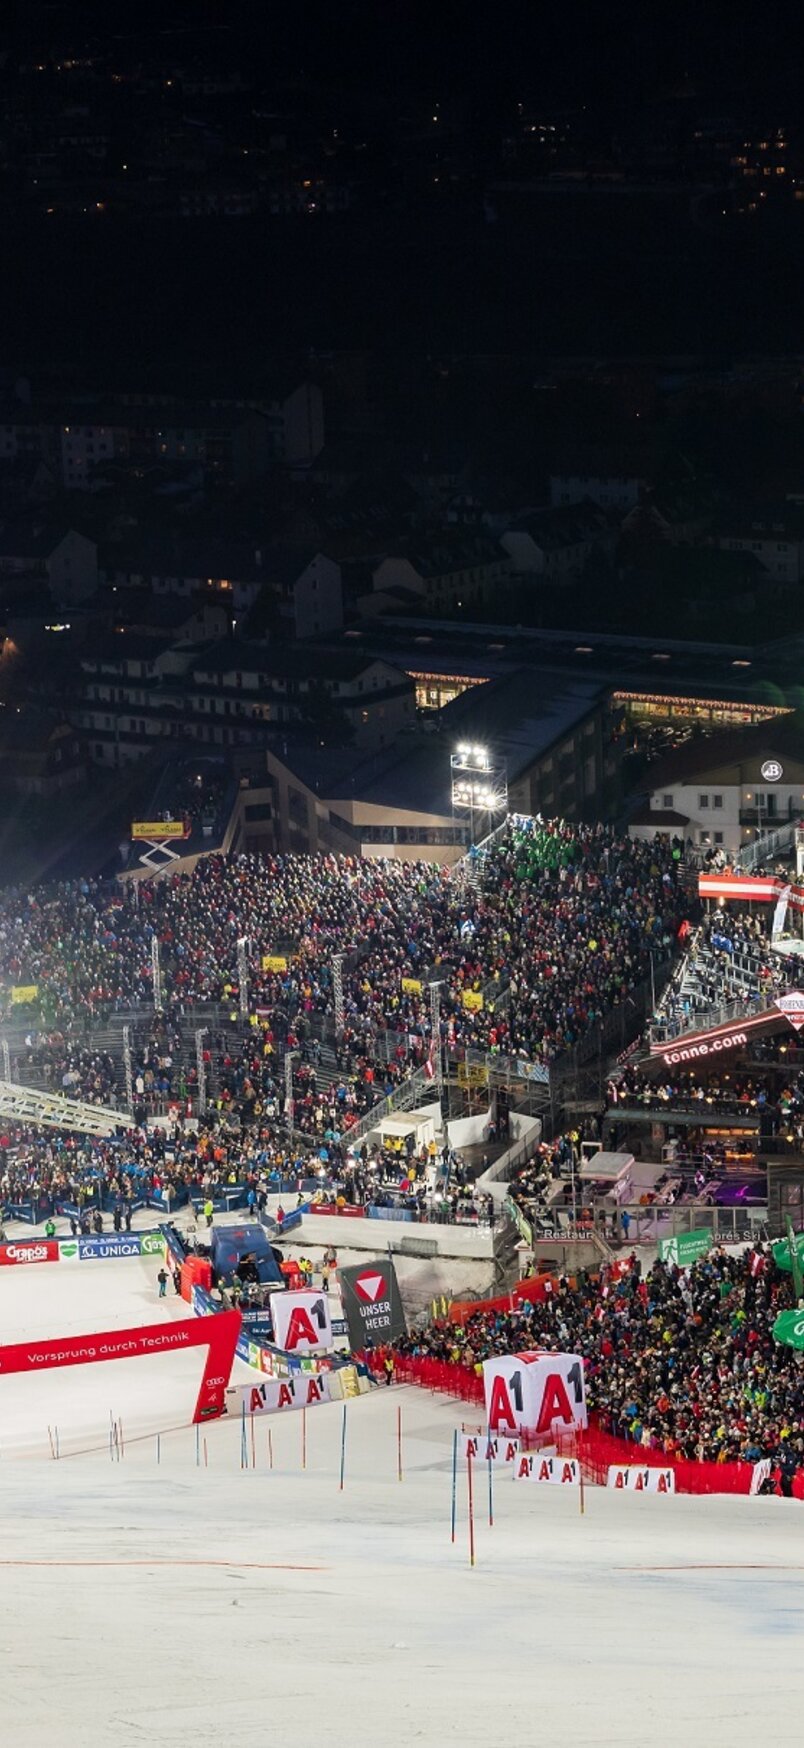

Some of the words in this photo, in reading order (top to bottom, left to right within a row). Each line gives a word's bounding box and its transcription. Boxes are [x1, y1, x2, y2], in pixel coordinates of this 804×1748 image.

[100, 1245, 140, 1256] UNIQA
[359, 1301, 391, 1317] UNSER
[285, 1299, 326, 1350] A1
[365, 1316, 391, 1330] HEER
[27, 1347, 96, 1363] Vorsprung
[99, 1340, 137, 1354] durch
[139, 1331, 190, 1348] Technik
[250, 1384, 267, 1411] A1
[278, 1380, 295, 1408] A1
[306, 1375, 324, 1403] A1
[490, 1370, 523, 1429] A1
[536, 1362, 583, 1433] A1
[466, 1437, 478, 1458] A1
[485, 1439, 498, 1459] A1
[505, 1441, 518, 1461] A1
[518, 1456, 533, 1478] A1
[538, 1458, 553, 1480] A1
[561, 1461, 576, 1483] A1
[615, 1469, 629, 1488] A1
[635, 1469, 649, 1490] A1
[657, 1470, 671, 1492] A1
